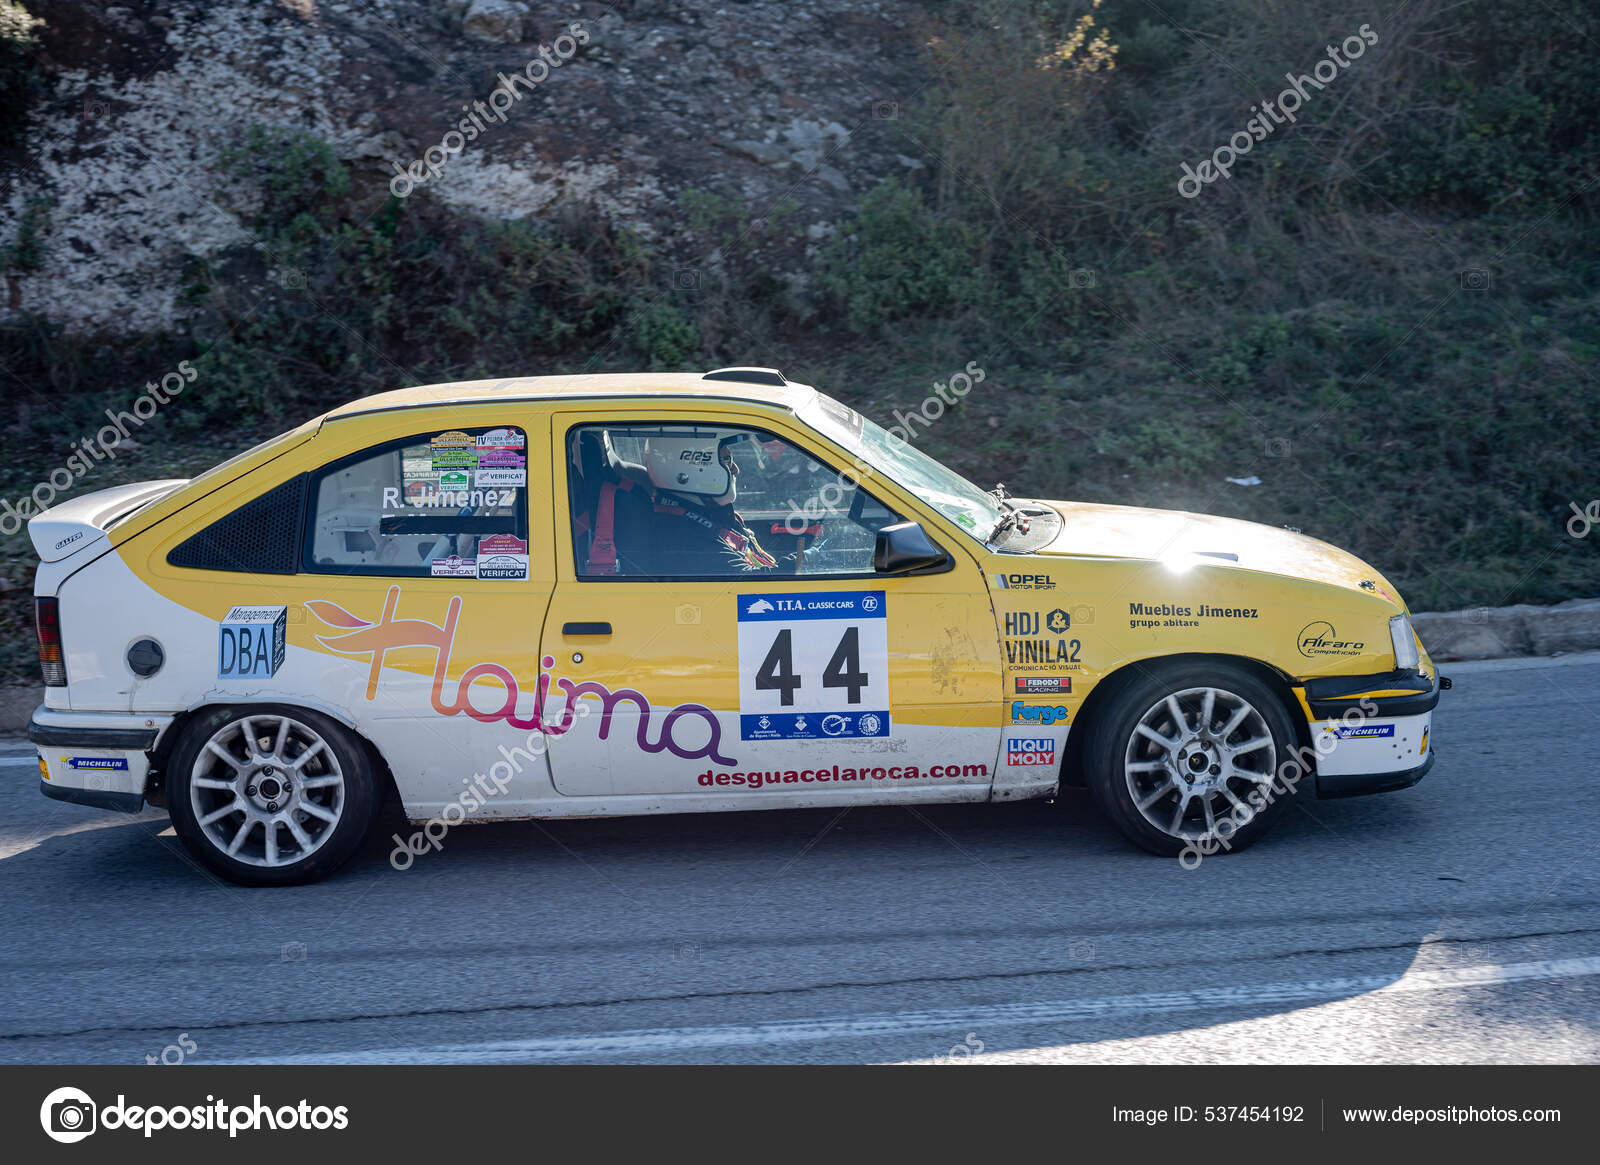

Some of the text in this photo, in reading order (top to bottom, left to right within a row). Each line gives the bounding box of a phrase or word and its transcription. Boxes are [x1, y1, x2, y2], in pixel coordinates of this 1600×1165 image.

[680, 450, 712, 461] RRS
[383, 486, 511, 509] R. Jimenez
[1009, 574, 1056, 585] OPEL
[776, 600, 806, 611] T.T.A.
[807, 601, 835, 609] CLASSIC
[1129, 603, 1258, 618] Muebles Jimenez
[228, 607, 282, 623] Management
[1005, 611, 1039, 636] HDJ
[1130, 619, 1199, 628] grupo abitare
[220, 627, 270, 675] DBA
[1302, 638, 1365, 649] Alfaro
[1005, 639, 1081, 664] VINILA2
[304, 585, 738, 766] Haima
[1012, 700, 1068, 725] Forge
[1342, 728, 1390, 736] MICHELIN
[1009, 740, 1053, 752] LIQUI
[1009, 753, 1054, 765] MOLY
[697, 764, 987, 788] desguacelaroca.com
